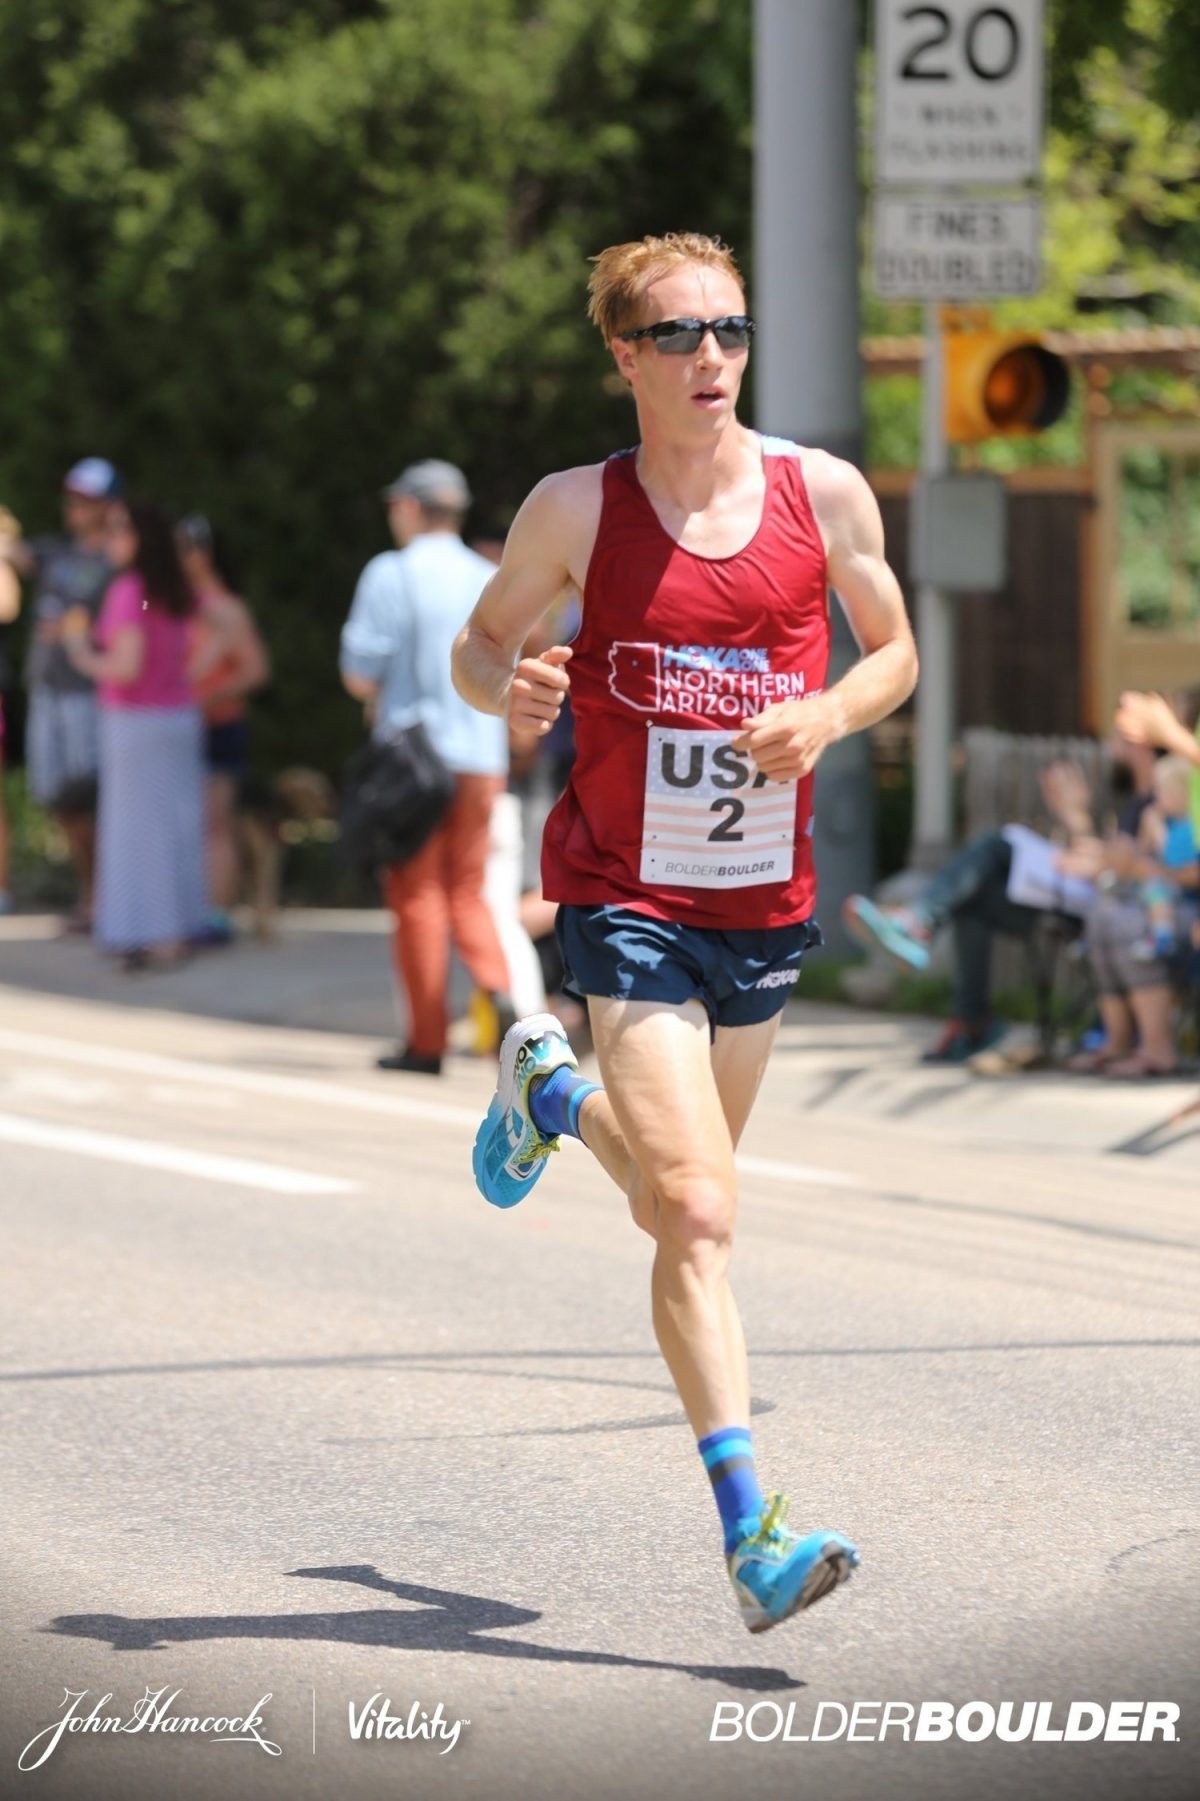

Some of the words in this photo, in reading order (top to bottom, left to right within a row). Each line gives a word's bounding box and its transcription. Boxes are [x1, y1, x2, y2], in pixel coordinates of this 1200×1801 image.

[898, 6, 1021, 82] 20
[905, 209, 1009, 240] FINES
[663, 645, 742, 671] HOKA
[740, 648, 768, 660] ONE
[740, 659, 770, 672] ONE
[664, 670, 805, 696] NORTHERN
[707, 797, 745, 842] 2
